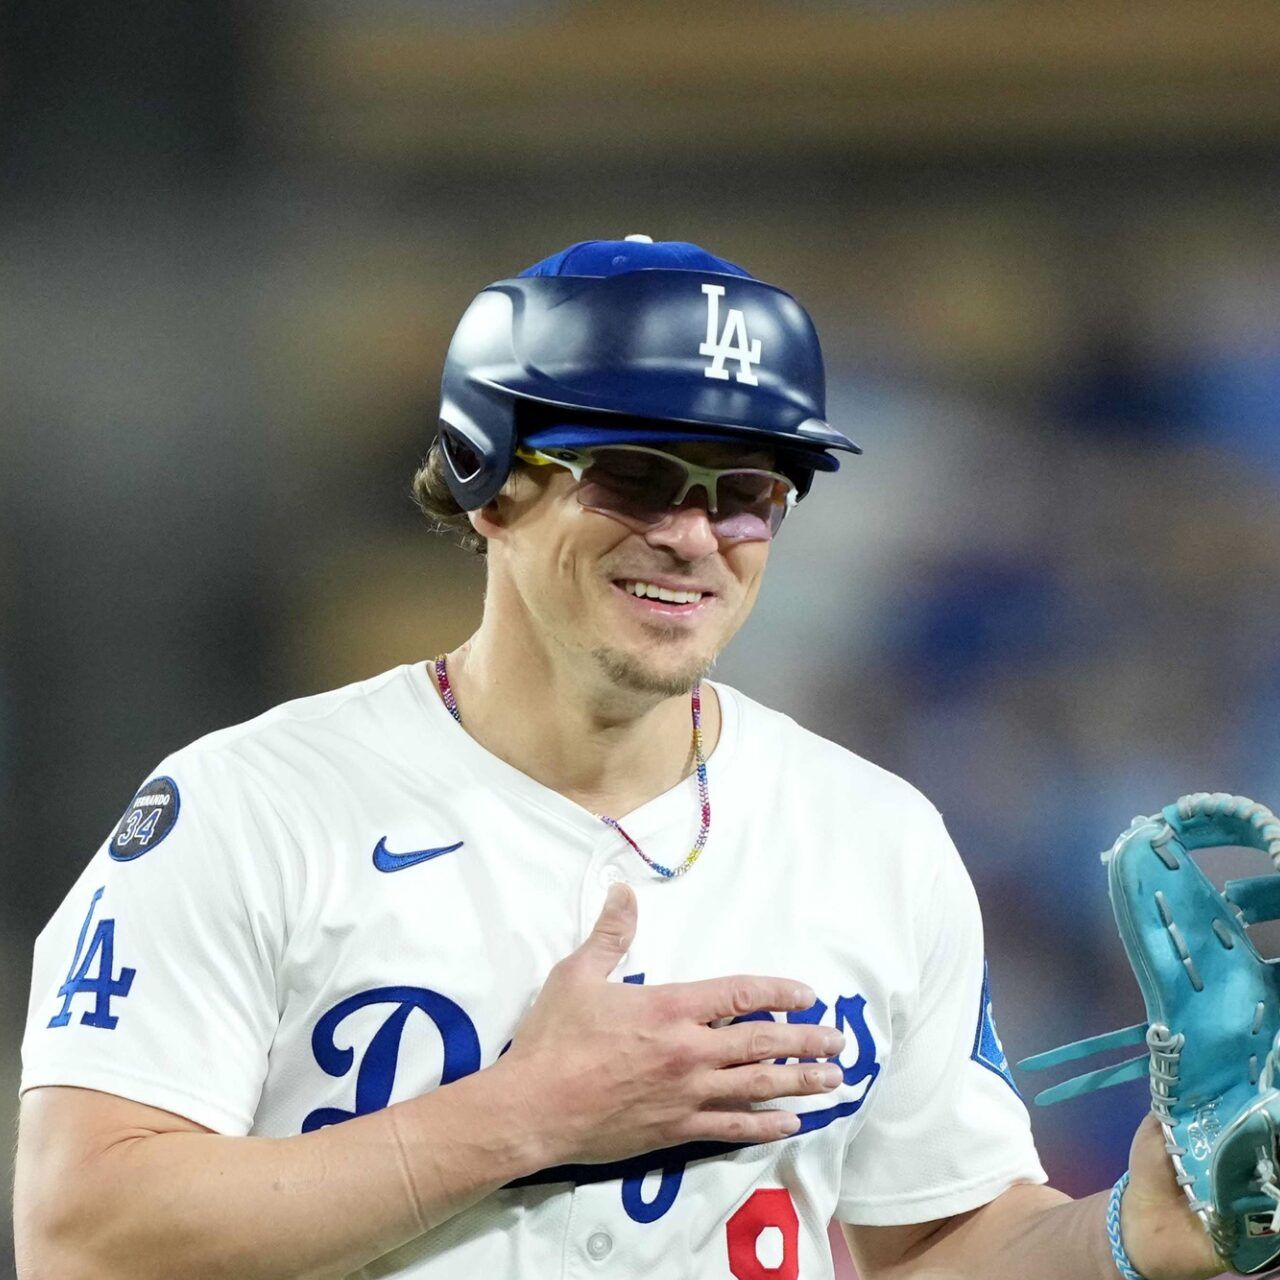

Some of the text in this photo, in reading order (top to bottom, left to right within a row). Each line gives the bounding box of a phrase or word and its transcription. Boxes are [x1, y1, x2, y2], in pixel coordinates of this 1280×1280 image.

[699, 283, 762, 387] LA
[117, 808, 162, 846] 34
[46, 884, 137, 1031] LA
